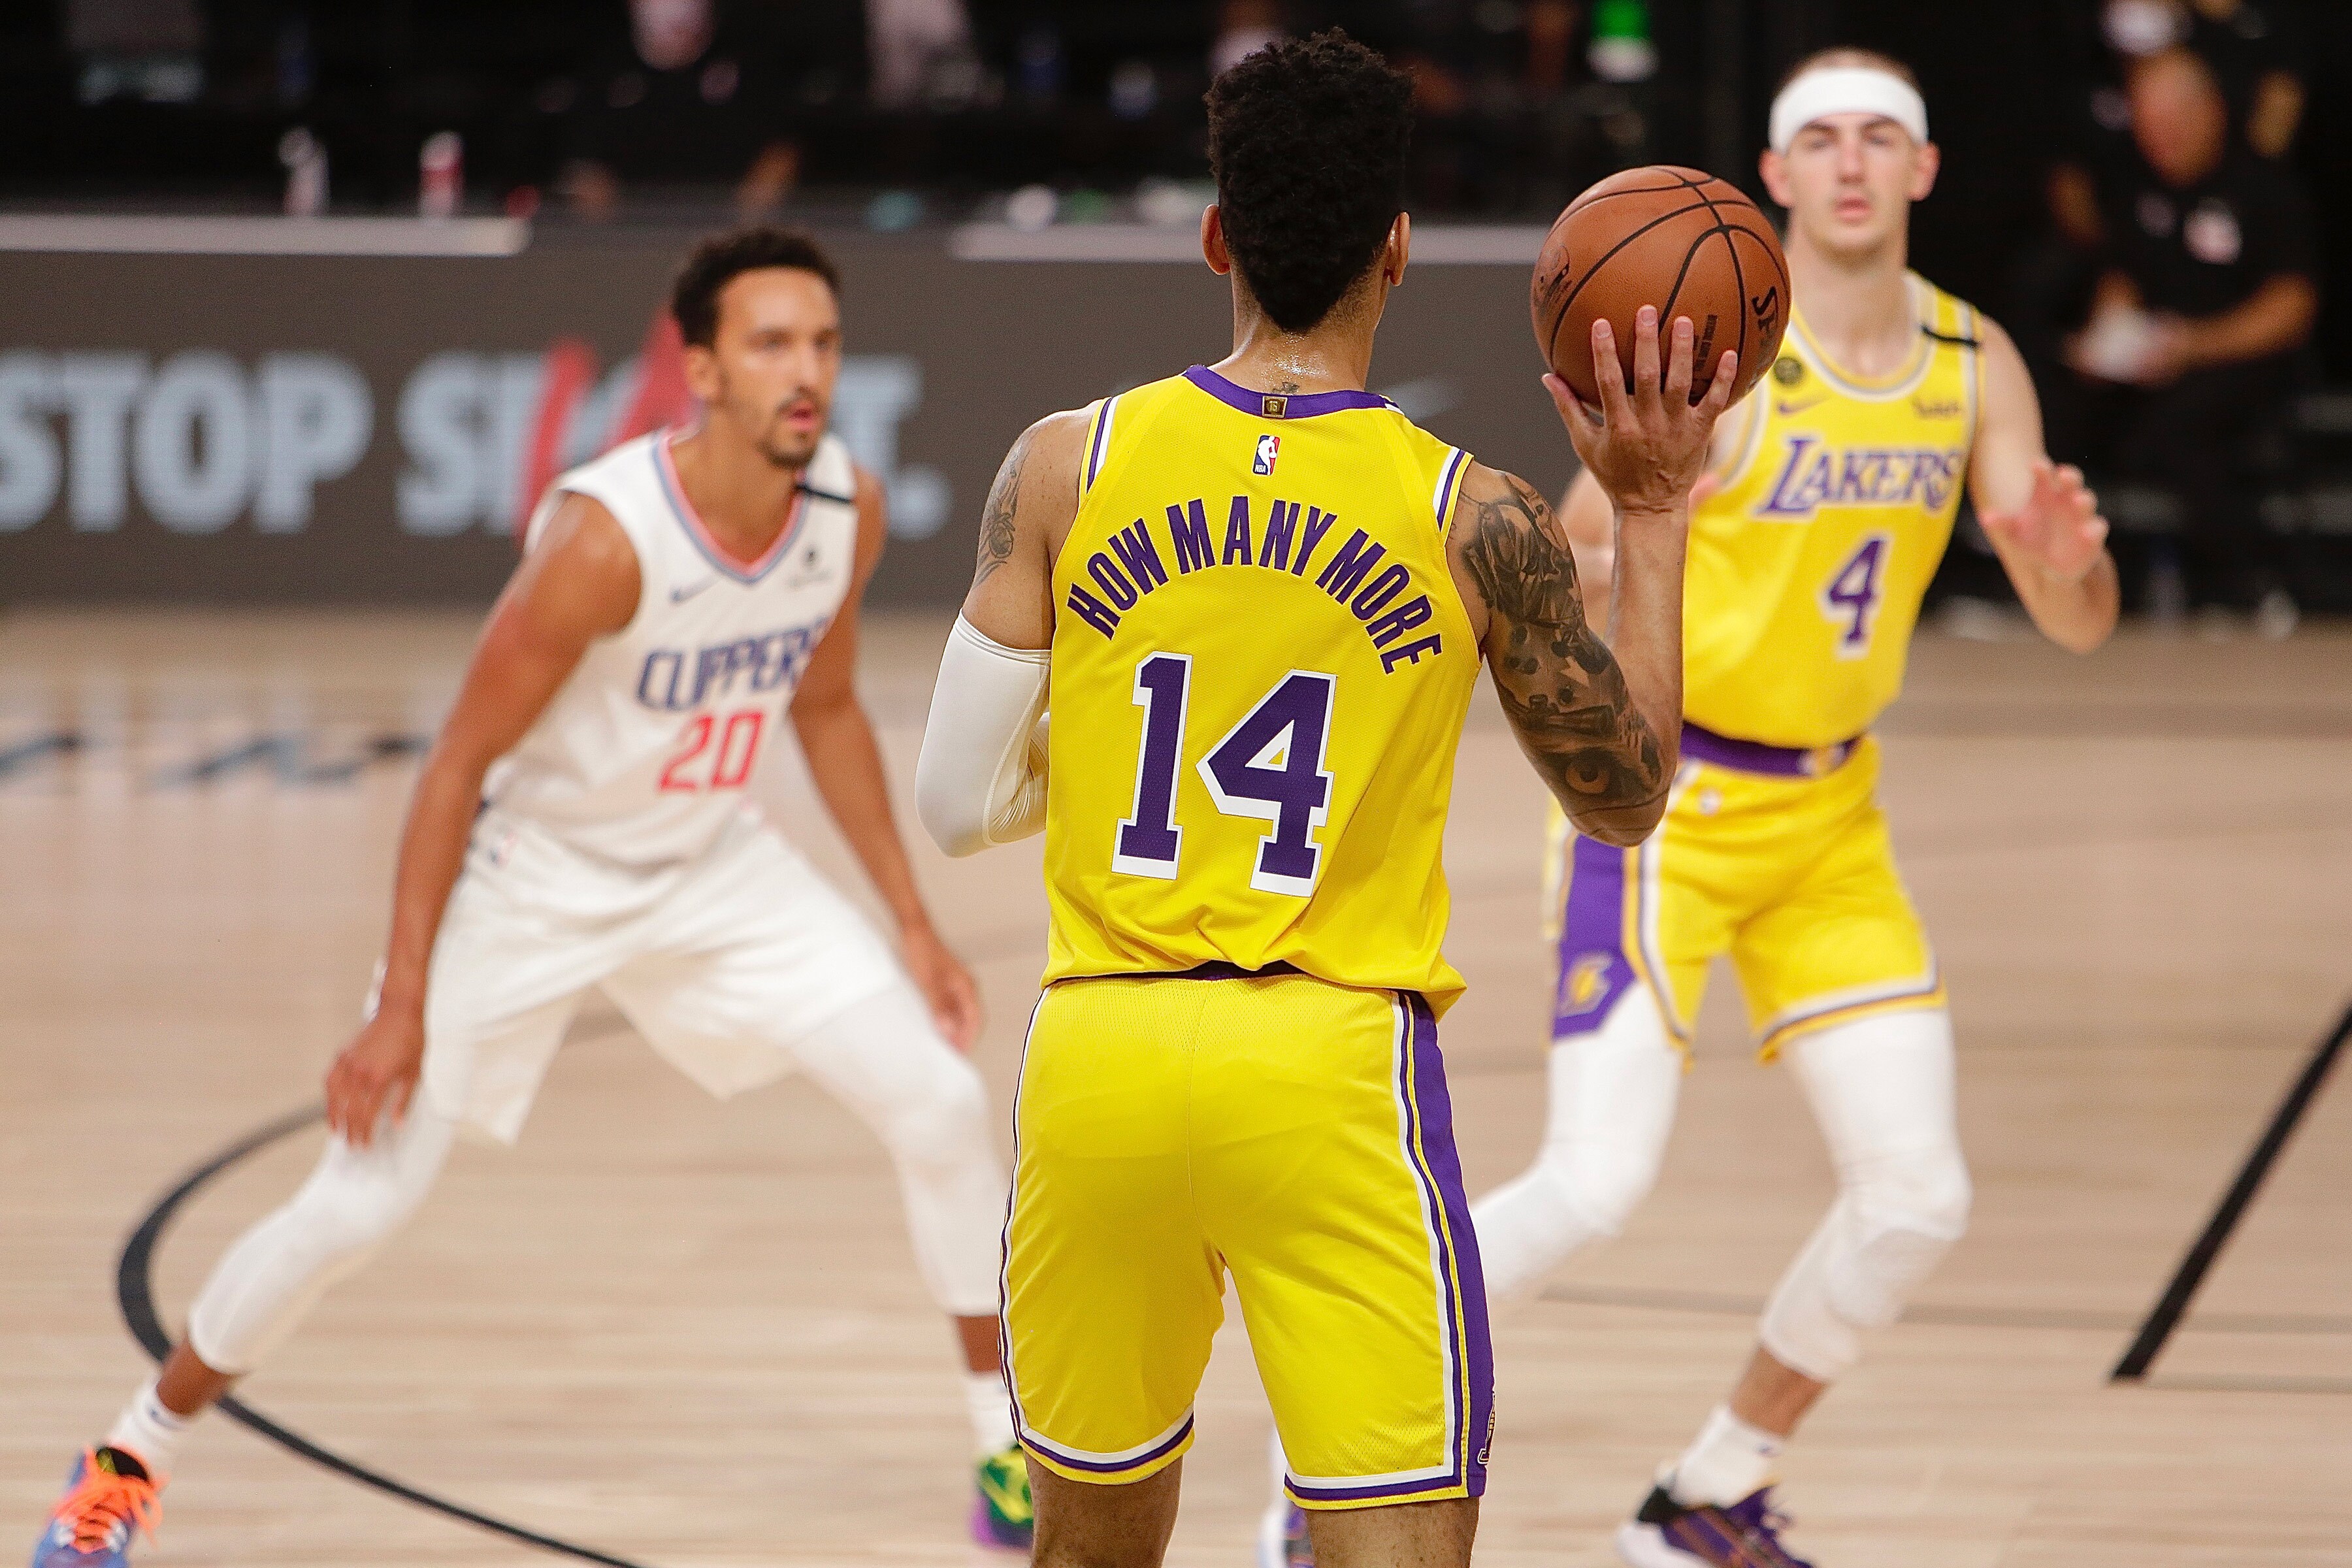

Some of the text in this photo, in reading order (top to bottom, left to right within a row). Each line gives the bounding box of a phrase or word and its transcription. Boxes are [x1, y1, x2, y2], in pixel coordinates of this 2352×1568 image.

[0, 350, 374, 534] STOP
[1254, 464, 1266, 473] NBA
[1755, 434, 1963, 515] LAKERS
[1067, 495, 1443, 675] HOW MANY MORE
[1820, 532, 1889, 659] 4
[657, 710, 766, 792] 20
[1111, 651, 1336, 898] 14
